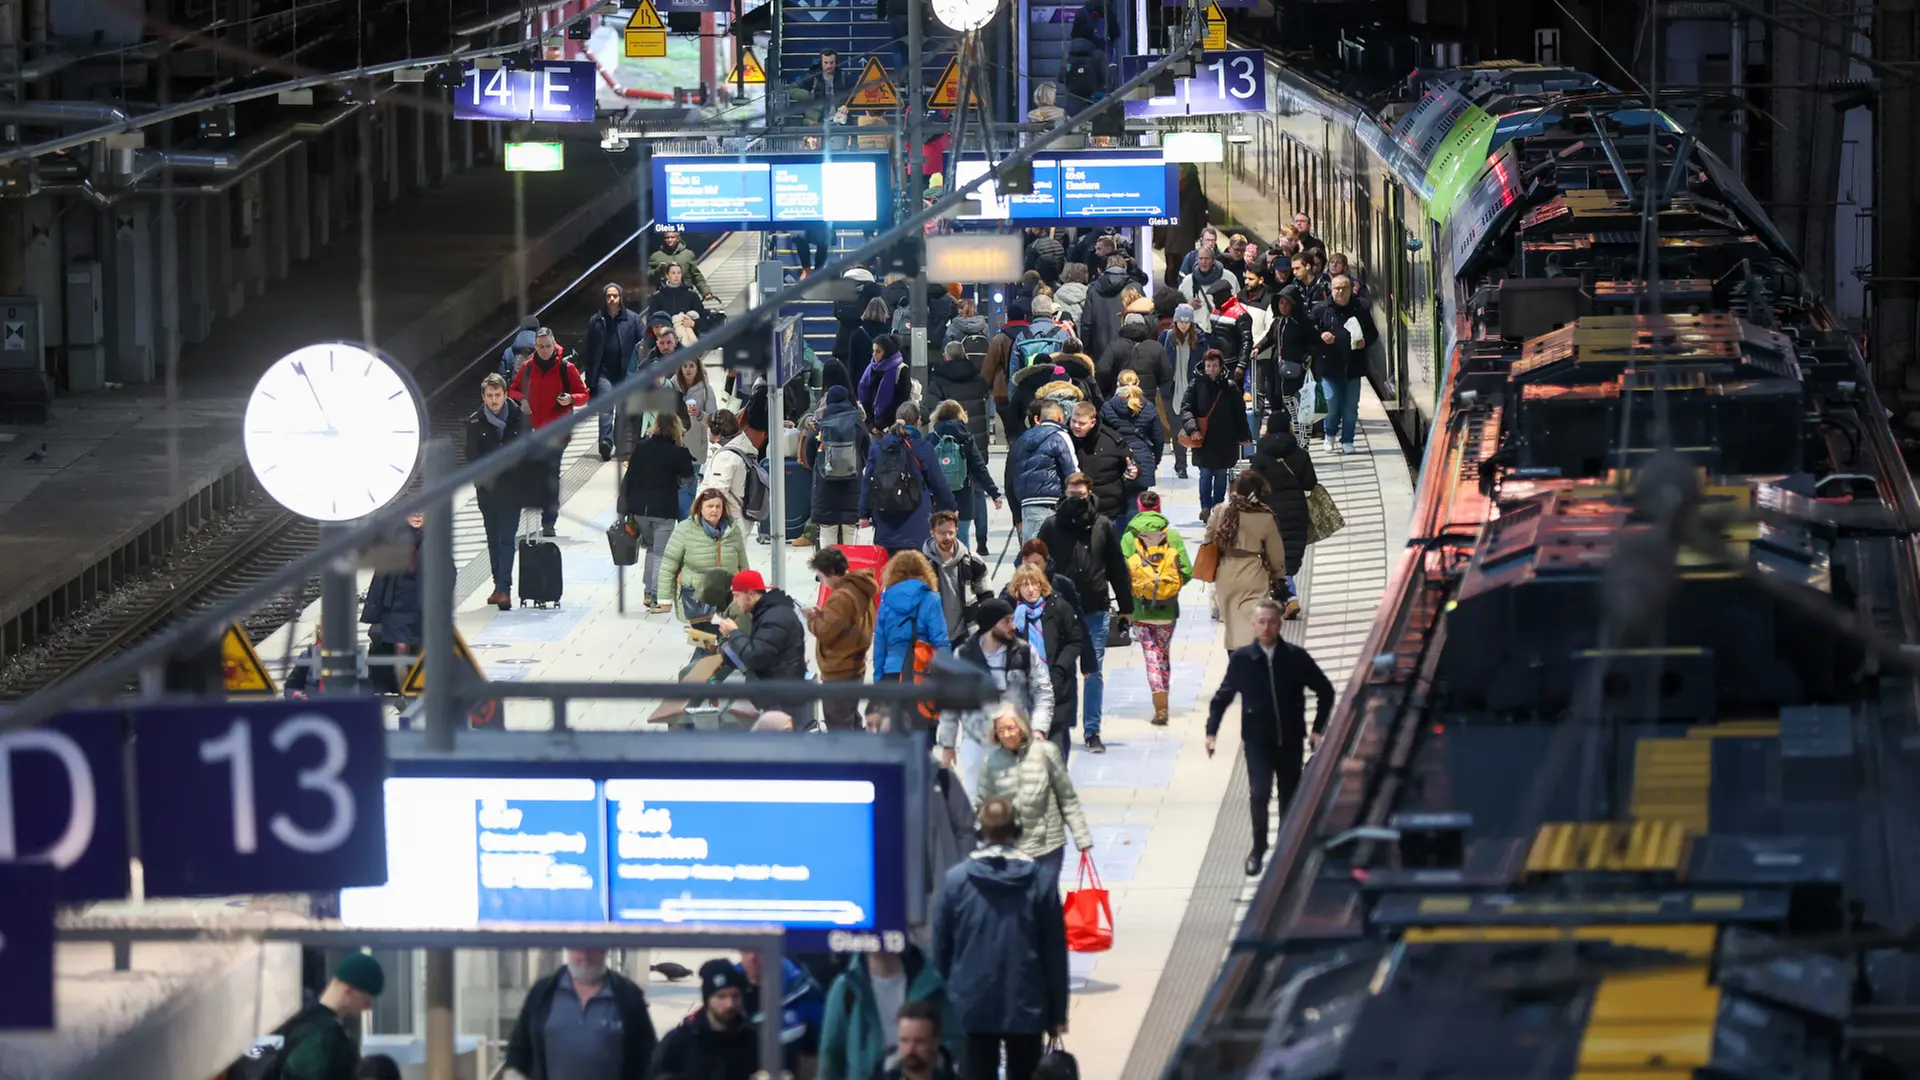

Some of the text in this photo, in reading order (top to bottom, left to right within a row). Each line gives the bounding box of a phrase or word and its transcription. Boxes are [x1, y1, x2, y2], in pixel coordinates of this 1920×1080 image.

[465, 66, 512, 106] 14
[543, 67, 572, 111] E
[1209, 56, 1257, 100] 13
[655, 223, 685, 232] Gleis 14
[1148, 217, 1178, 226] Gleis 13
[0, 727, 97, 871] D
[199, 712, 358, 854] 13
